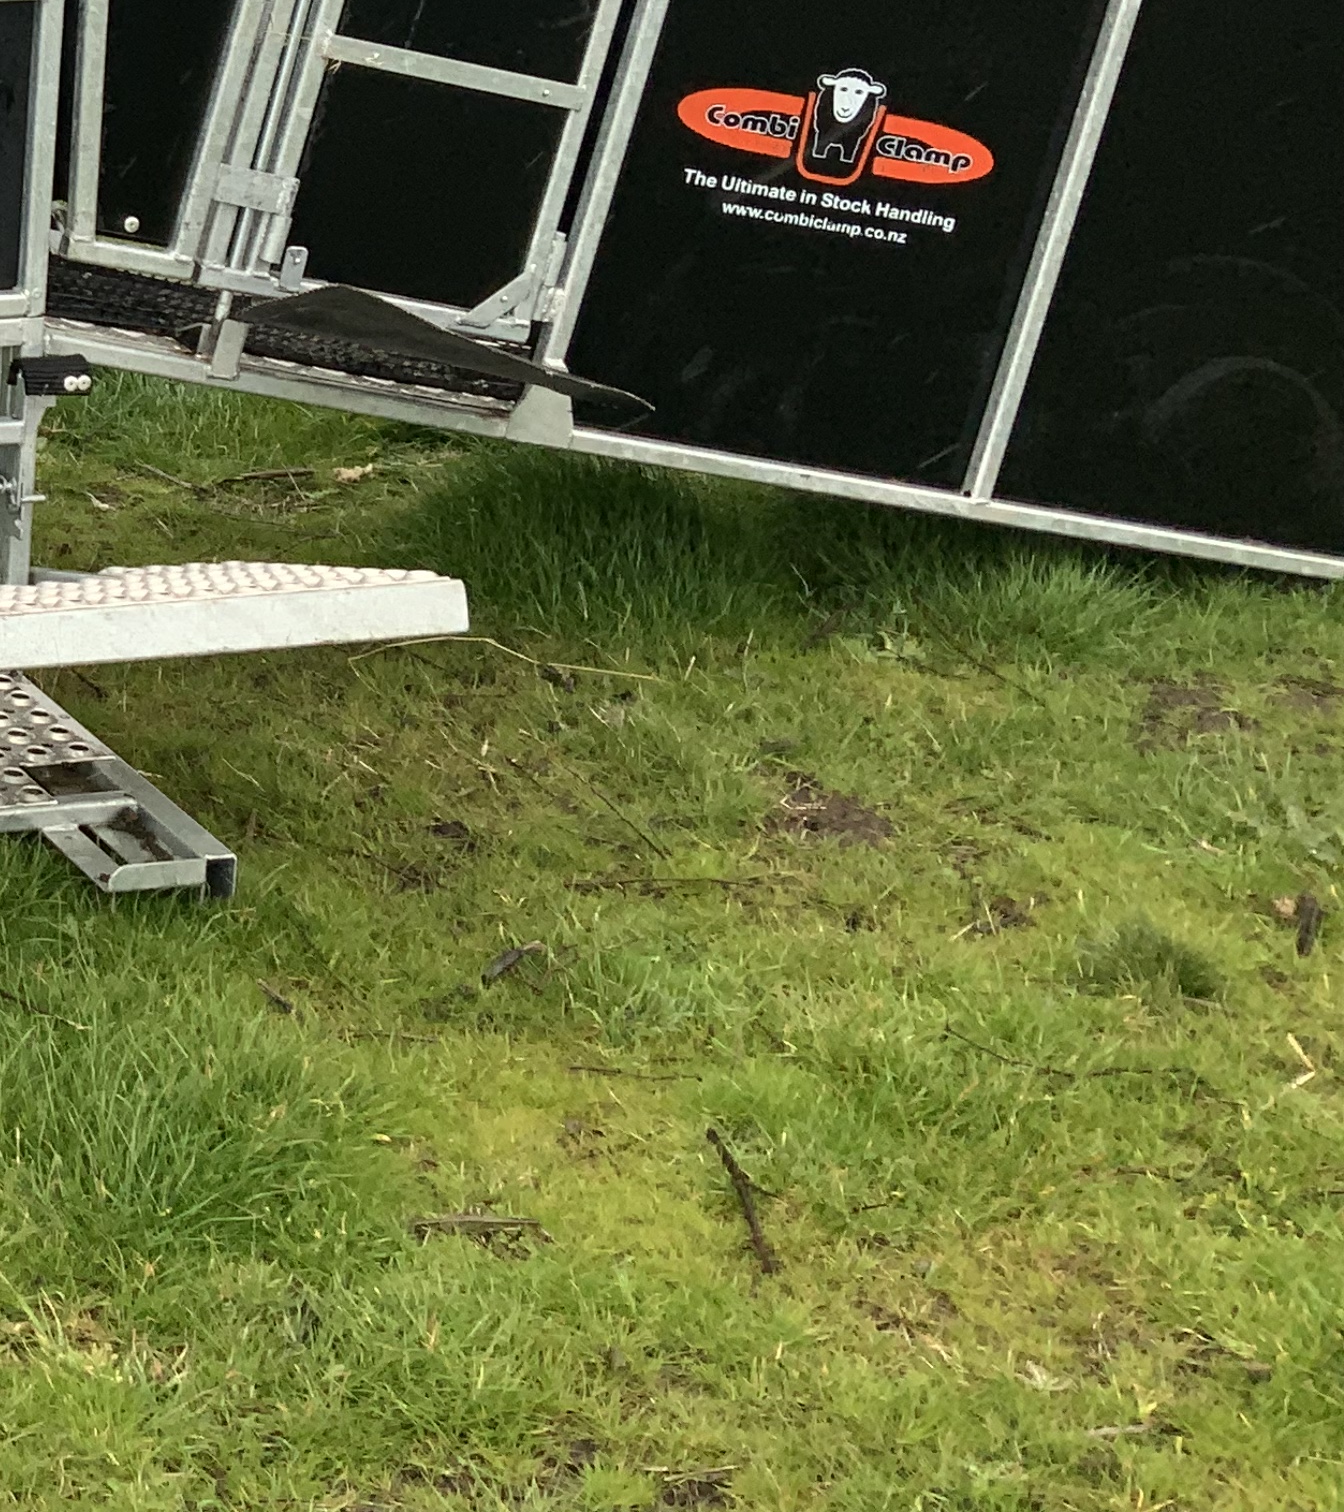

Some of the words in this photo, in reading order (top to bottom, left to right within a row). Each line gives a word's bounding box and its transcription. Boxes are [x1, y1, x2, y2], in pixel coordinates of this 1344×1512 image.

[705, 104, 800, 140] Combi
[875, 134, 973, 175] Clamp
[684, 168, 718, 189] The
[721, 174, 797, 203] Ultimate
[799, 189, 818, 206] in
[820, 192, 871, 216] Stock
[874, 201, 957, 233] Handling
